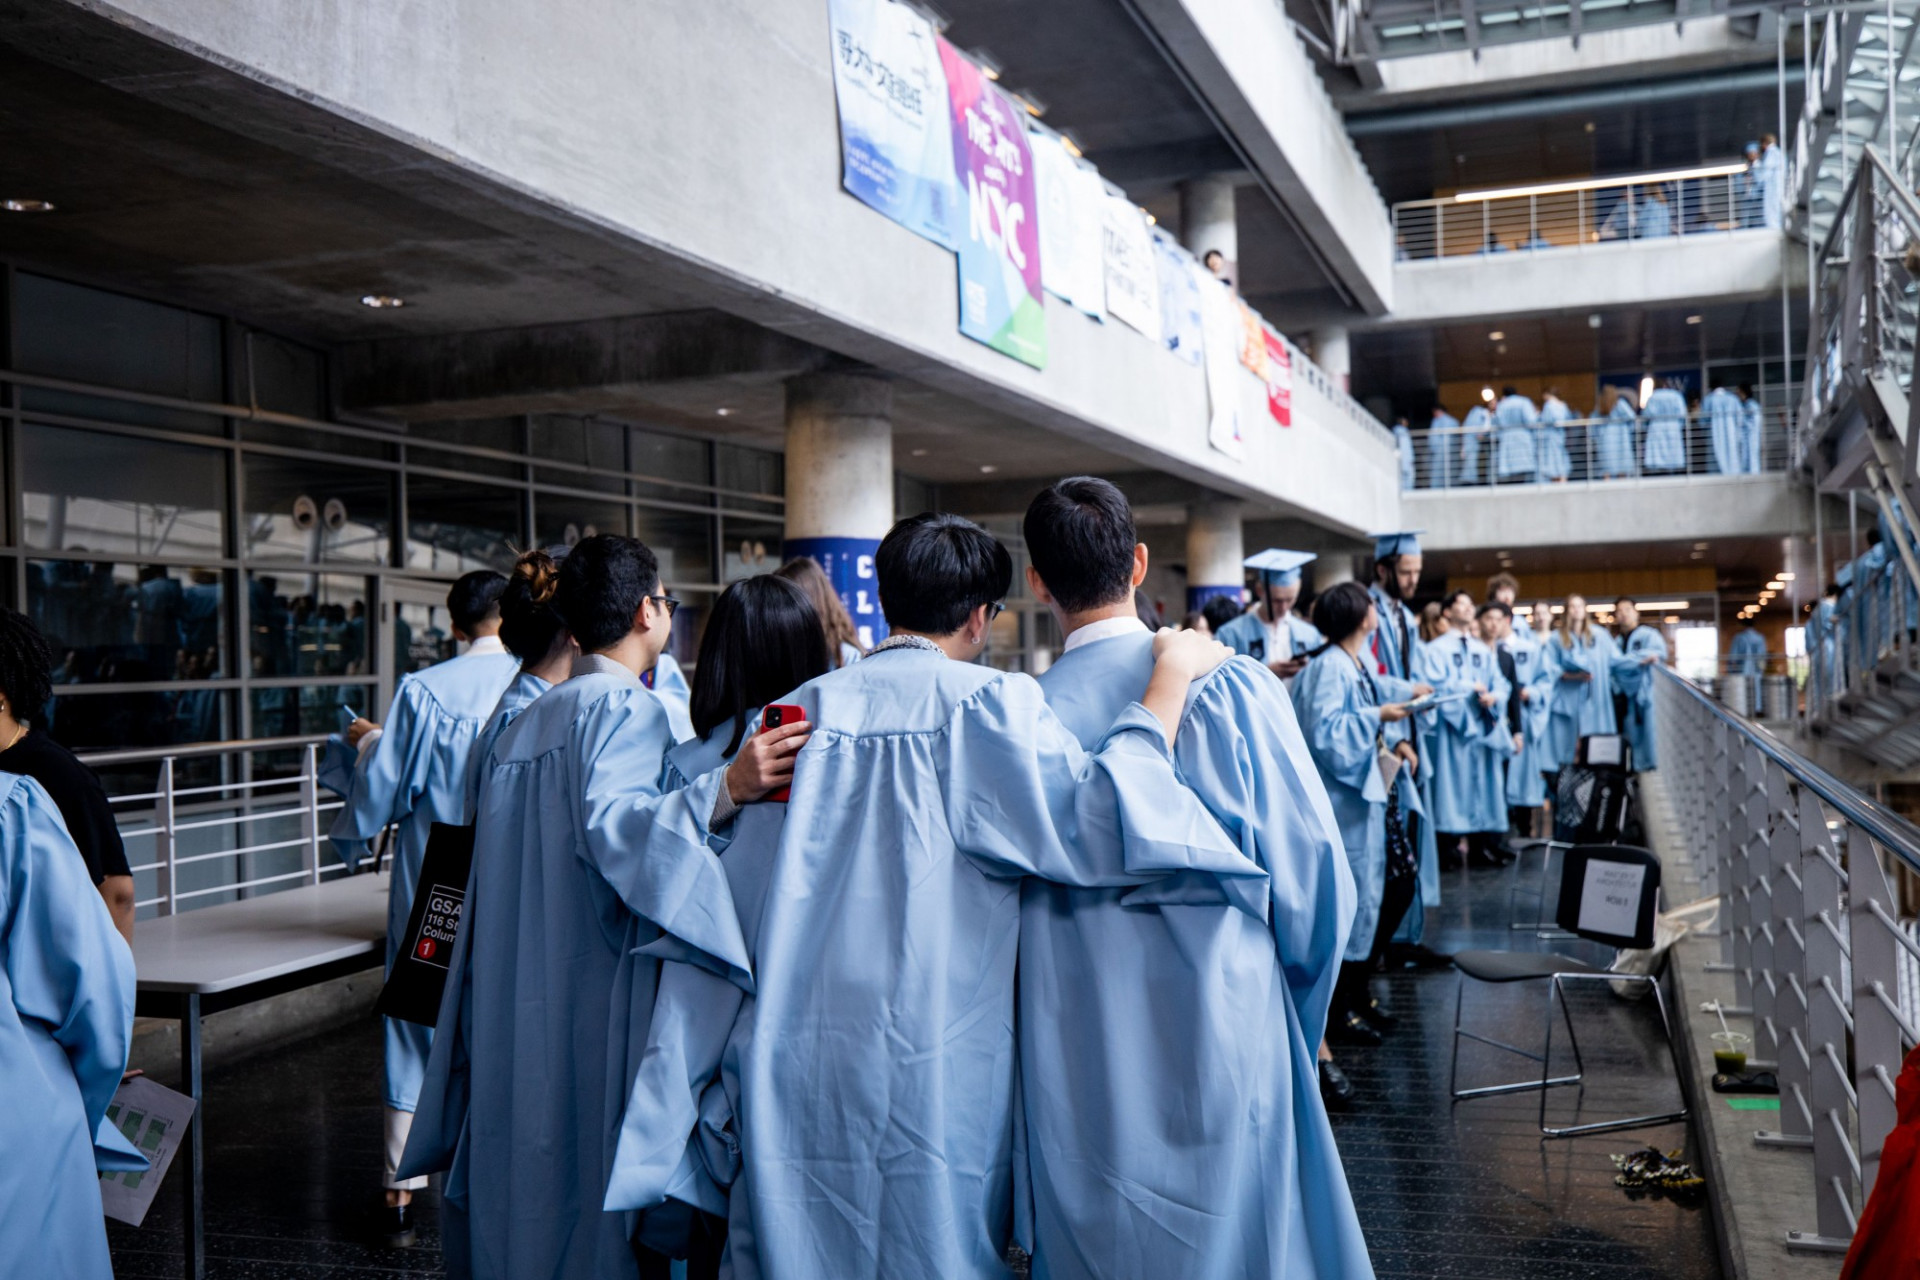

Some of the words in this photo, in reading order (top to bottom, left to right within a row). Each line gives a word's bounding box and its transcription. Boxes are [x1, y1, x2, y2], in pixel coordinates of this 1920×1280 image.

[968, 170, 1027, 270] NYC
[431, 898, 462, 917] GSA
[428, 913, 444, 927] 116
[445, 918, 459, 931] St
[423, 942, 431, 955] 1
